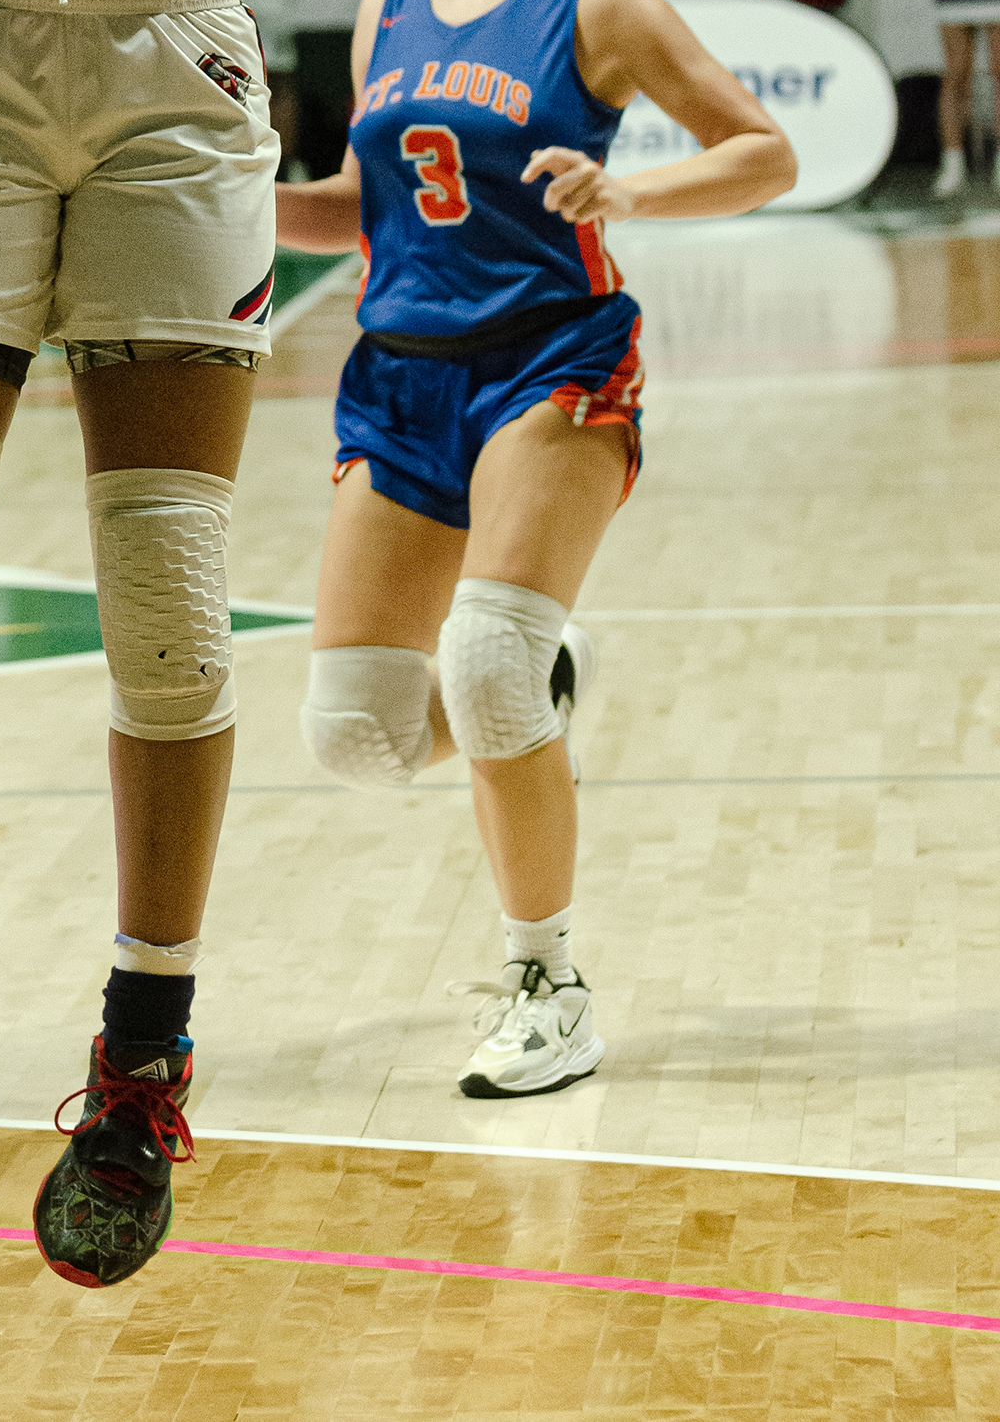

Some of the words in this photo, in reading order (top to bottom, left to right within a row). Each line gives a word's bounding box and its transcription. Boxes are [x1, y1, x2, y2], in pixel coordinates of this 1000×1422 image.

[350, 68, 403, 127] ST.
[412, 61, 532, 127] LOUIS
[400, 124, 472, 222] 3
